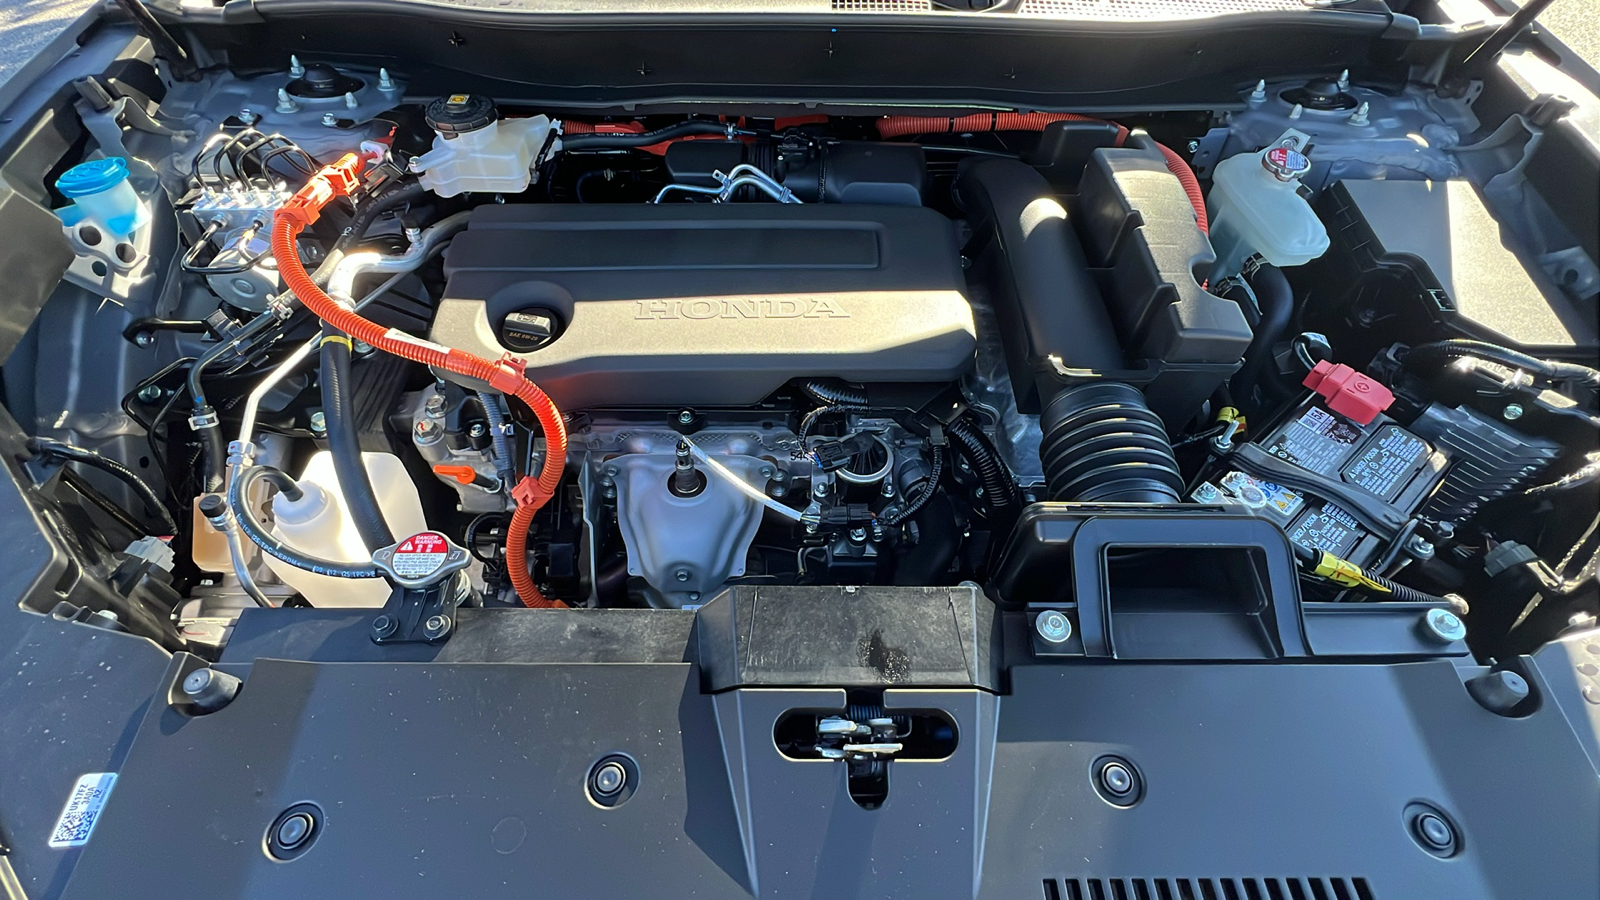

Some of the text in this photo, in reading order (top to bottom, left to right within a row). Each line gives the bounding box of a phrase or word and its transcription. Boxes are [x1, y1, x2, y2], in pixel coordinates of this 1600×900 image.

[635, 299, 851, 320] HONDA
[508, 331, 521, 339] SAE
[1311, 409, 1326, 421] 5A
[92, 789, 103, 798] A2
